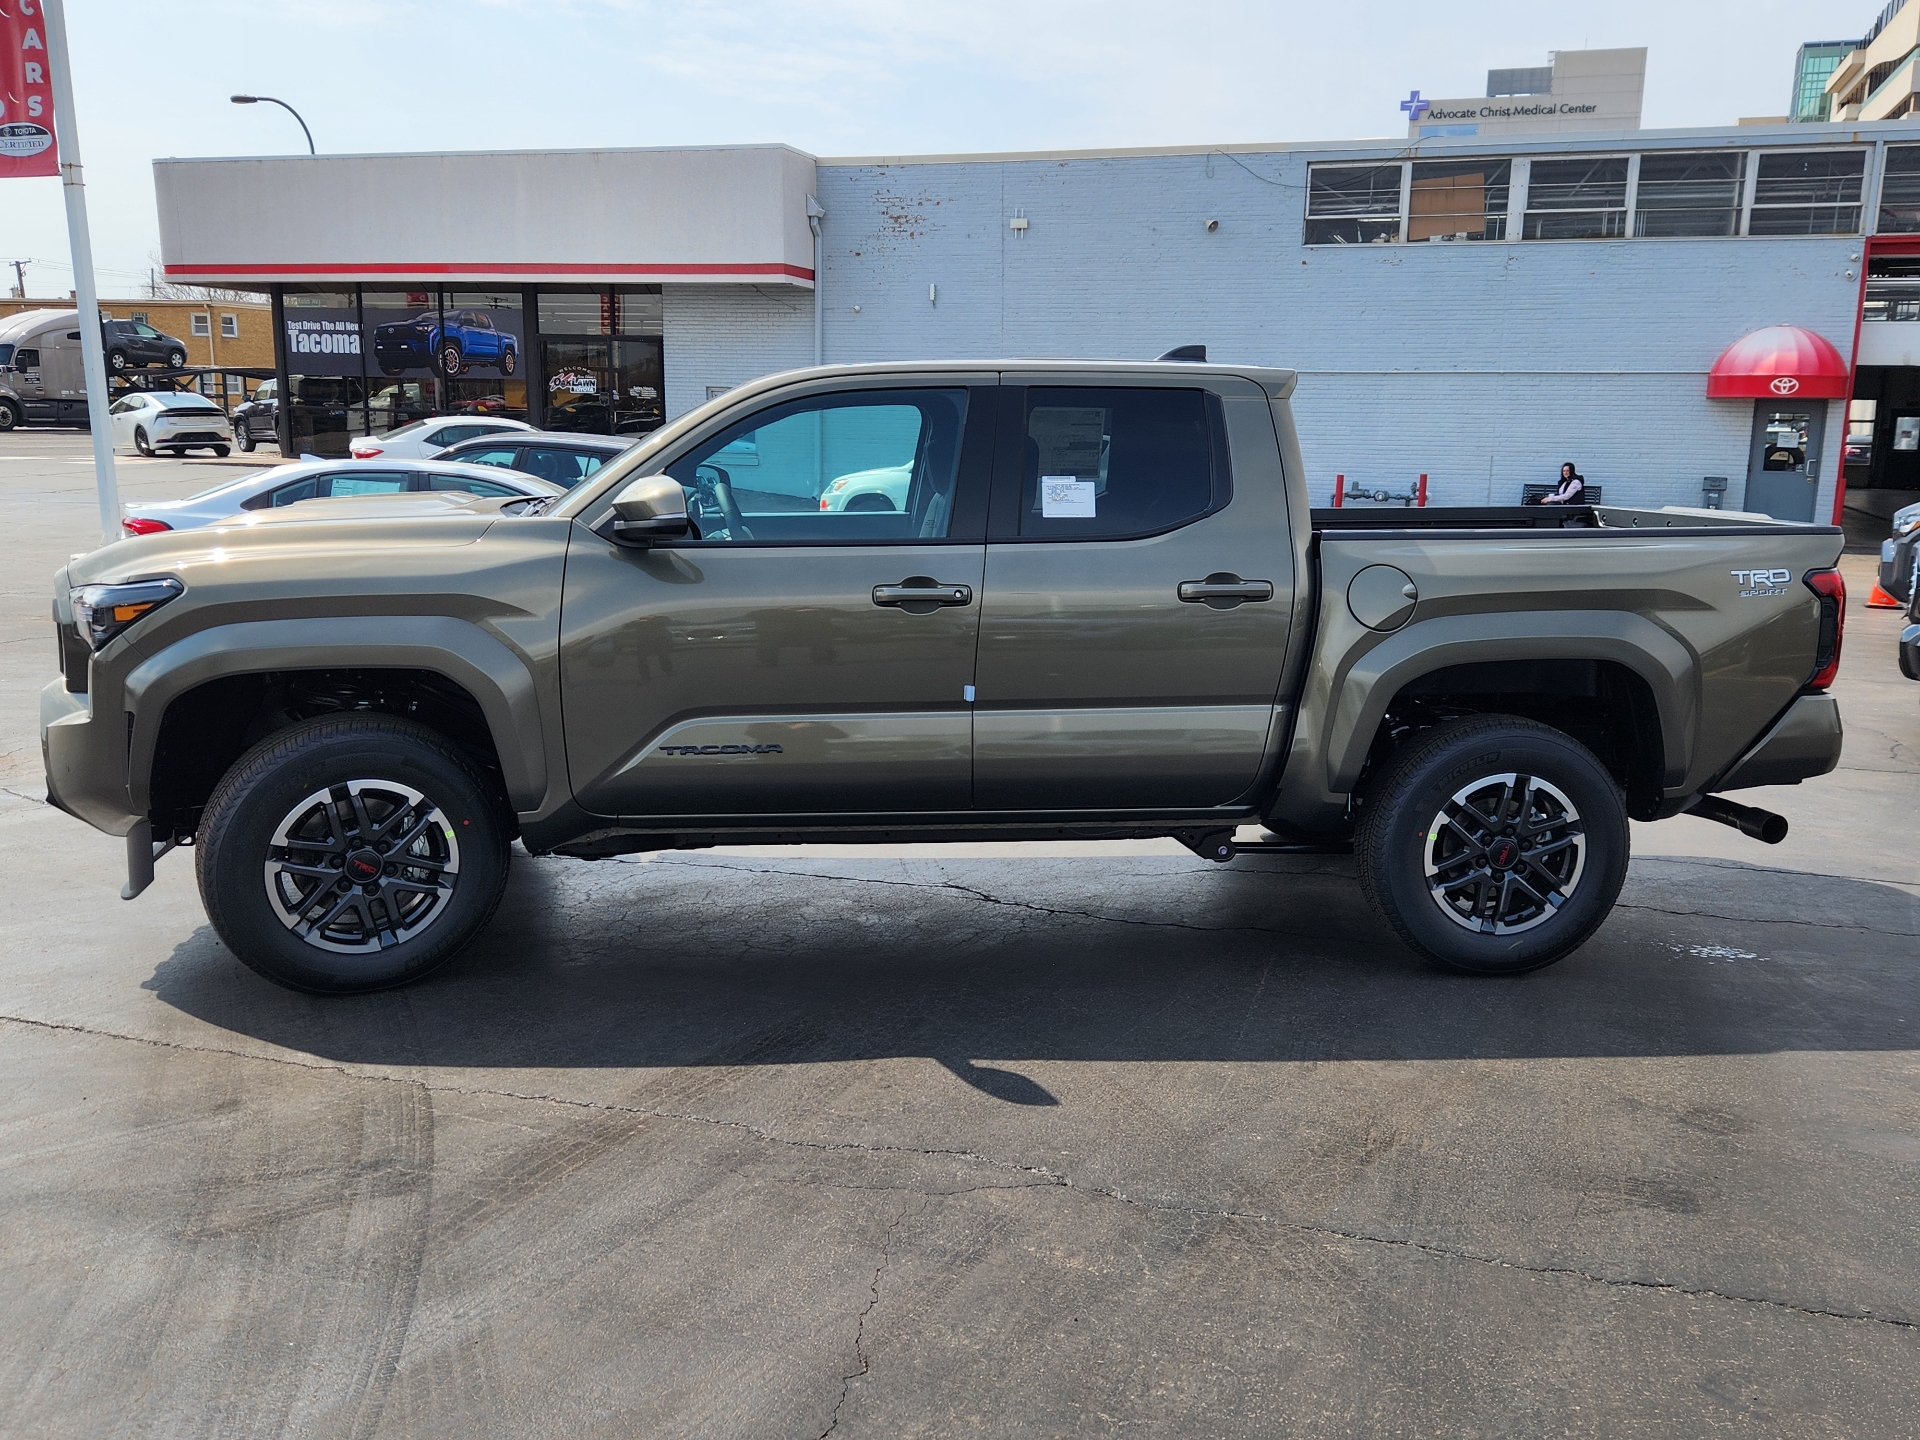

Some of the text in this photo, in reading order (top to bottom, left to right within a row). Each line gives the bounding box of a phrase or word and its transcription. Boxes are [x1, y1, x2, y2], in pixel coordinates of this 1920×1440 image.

[1427, 103, 1597, 120] Advocate Christ Medical Center
[13, 127, 37, 135] TOYOTA
[287, 321, 302, 330] Test
[303, 321, 320, 330] Drive
[321, 321, 335, 330] The
[335, 321, 345, 331] All
[288, 330, 362, 354] Tacoma
[558, 365, 592, 374] WELCOME
[1730, 568, 1791, 588] TRD
[1739, 588, 1788, 598] SPORT
[659, 744, 783, 756] TACOMA
[353, 859, 377, 874] TRD
